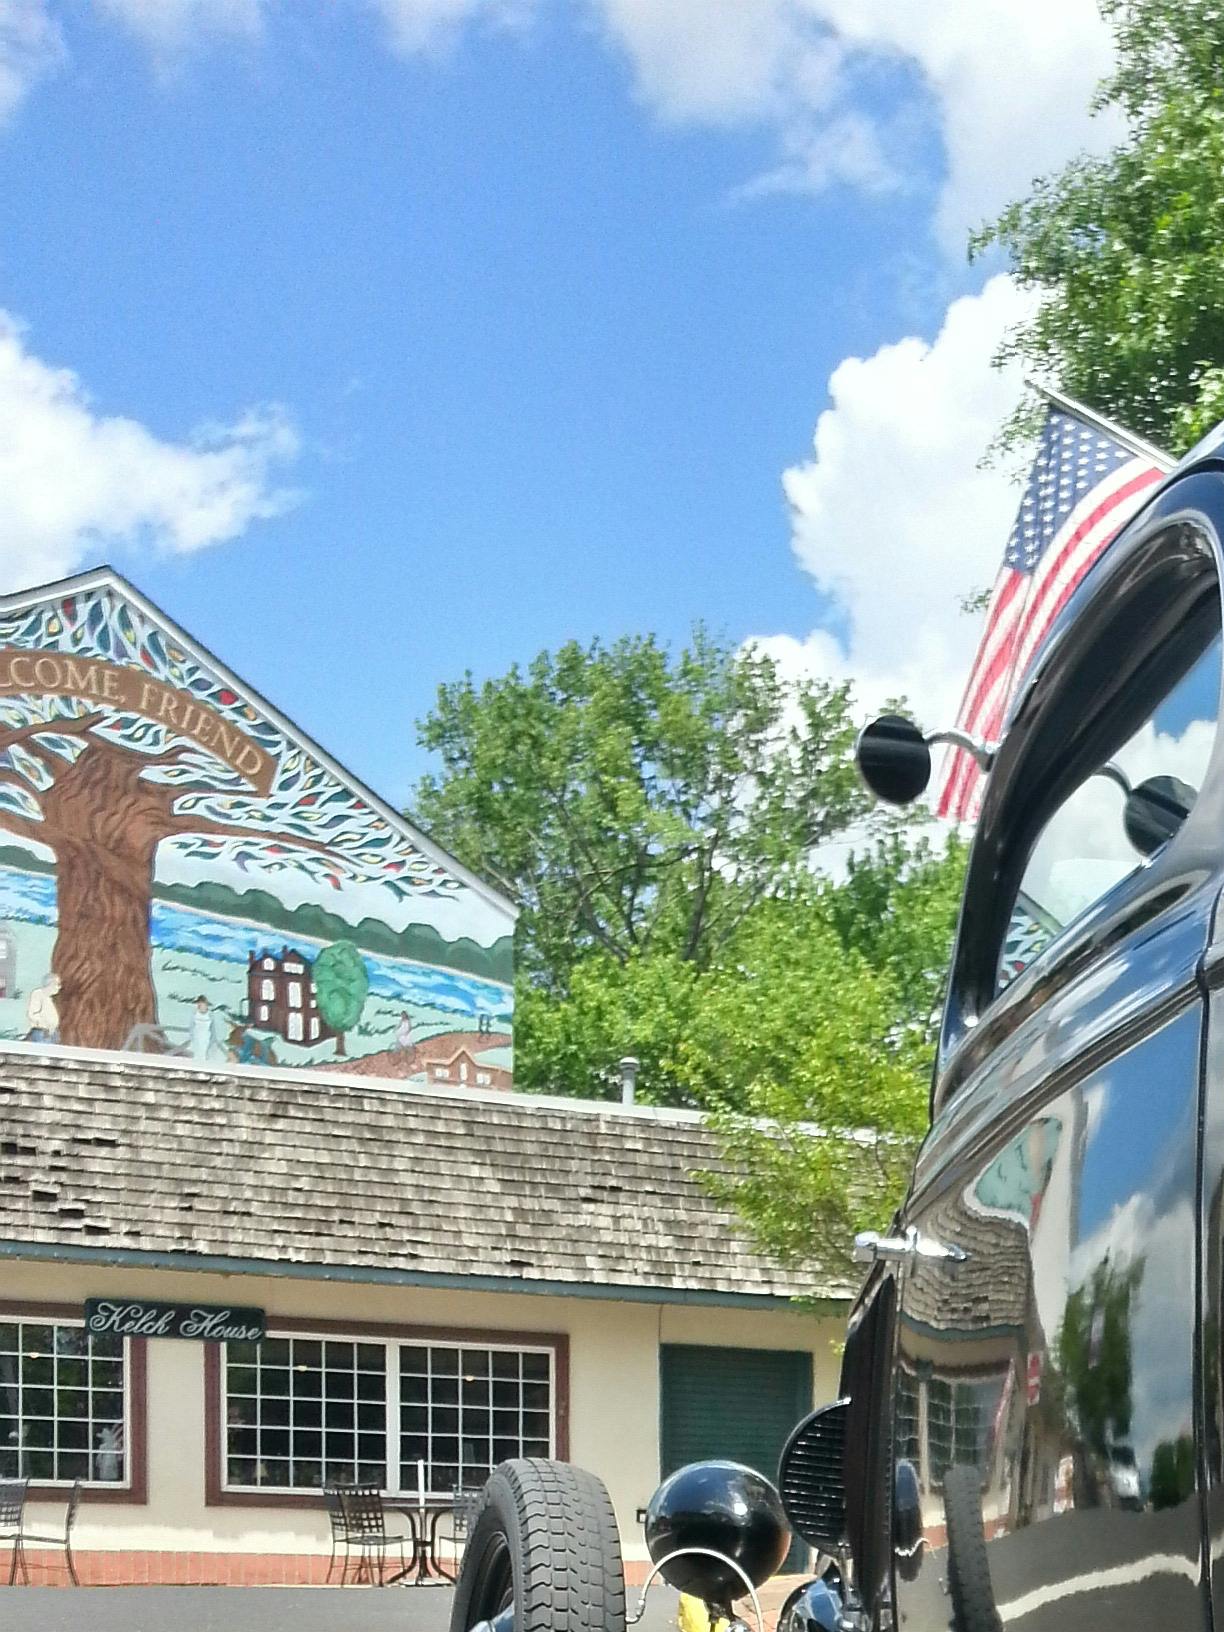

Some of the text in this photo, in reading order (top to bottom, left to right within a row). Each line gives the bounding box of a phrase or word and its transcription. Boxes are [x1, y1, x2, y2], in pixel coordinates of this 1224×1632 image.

[138, 682, 264, 776] FRIEND
[89, 1302, 263, 1341] Kelch House
